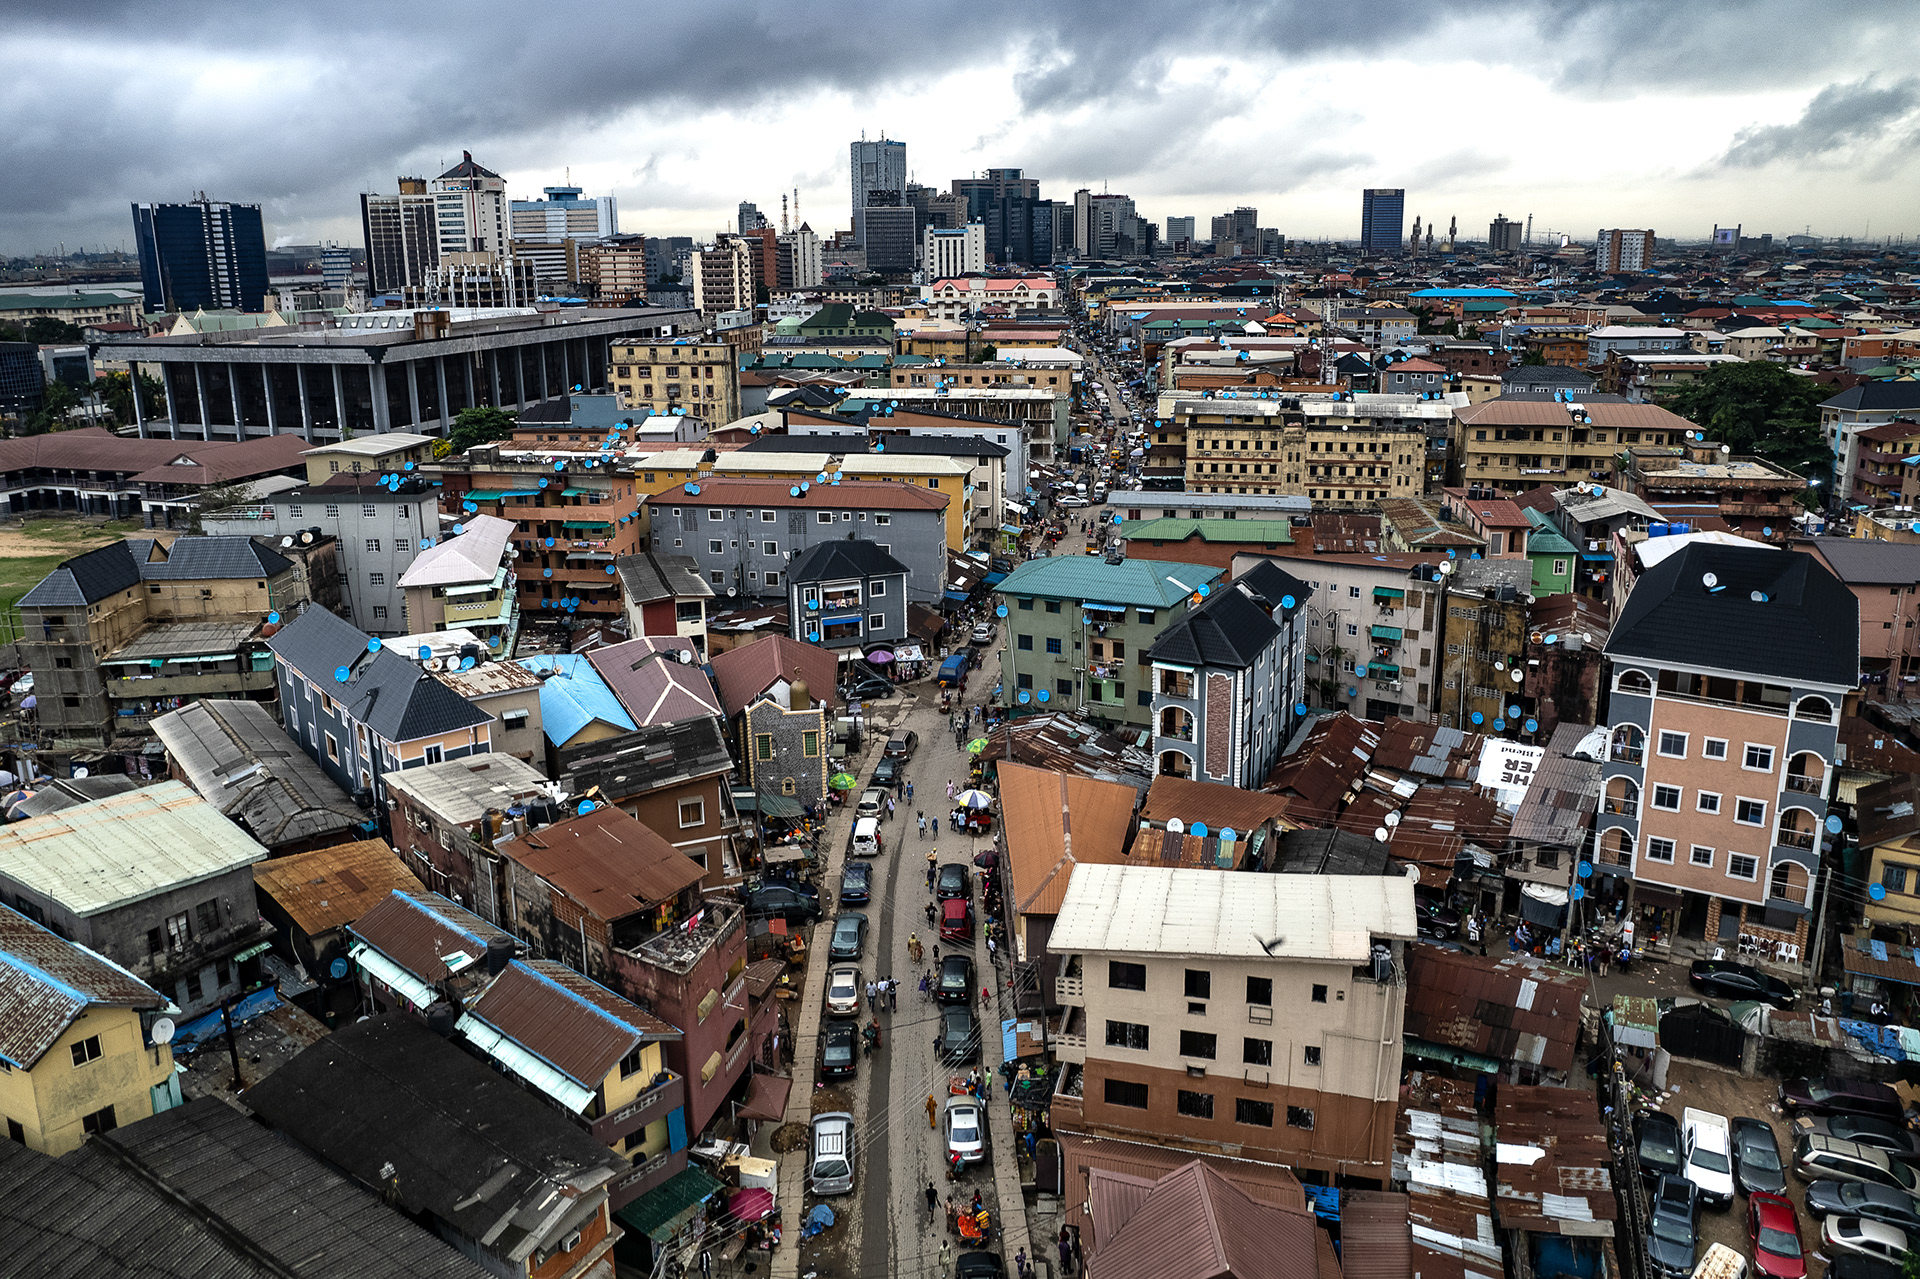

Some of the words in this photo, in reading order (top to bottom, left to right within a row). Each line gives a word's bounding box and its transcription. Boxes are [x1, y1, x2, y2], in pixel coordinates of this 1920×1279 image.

[1501, 747, 1534, 757] Blend
[1504, 759, 1536, 774] ER
[1501, 772, 1531, 786] HE
